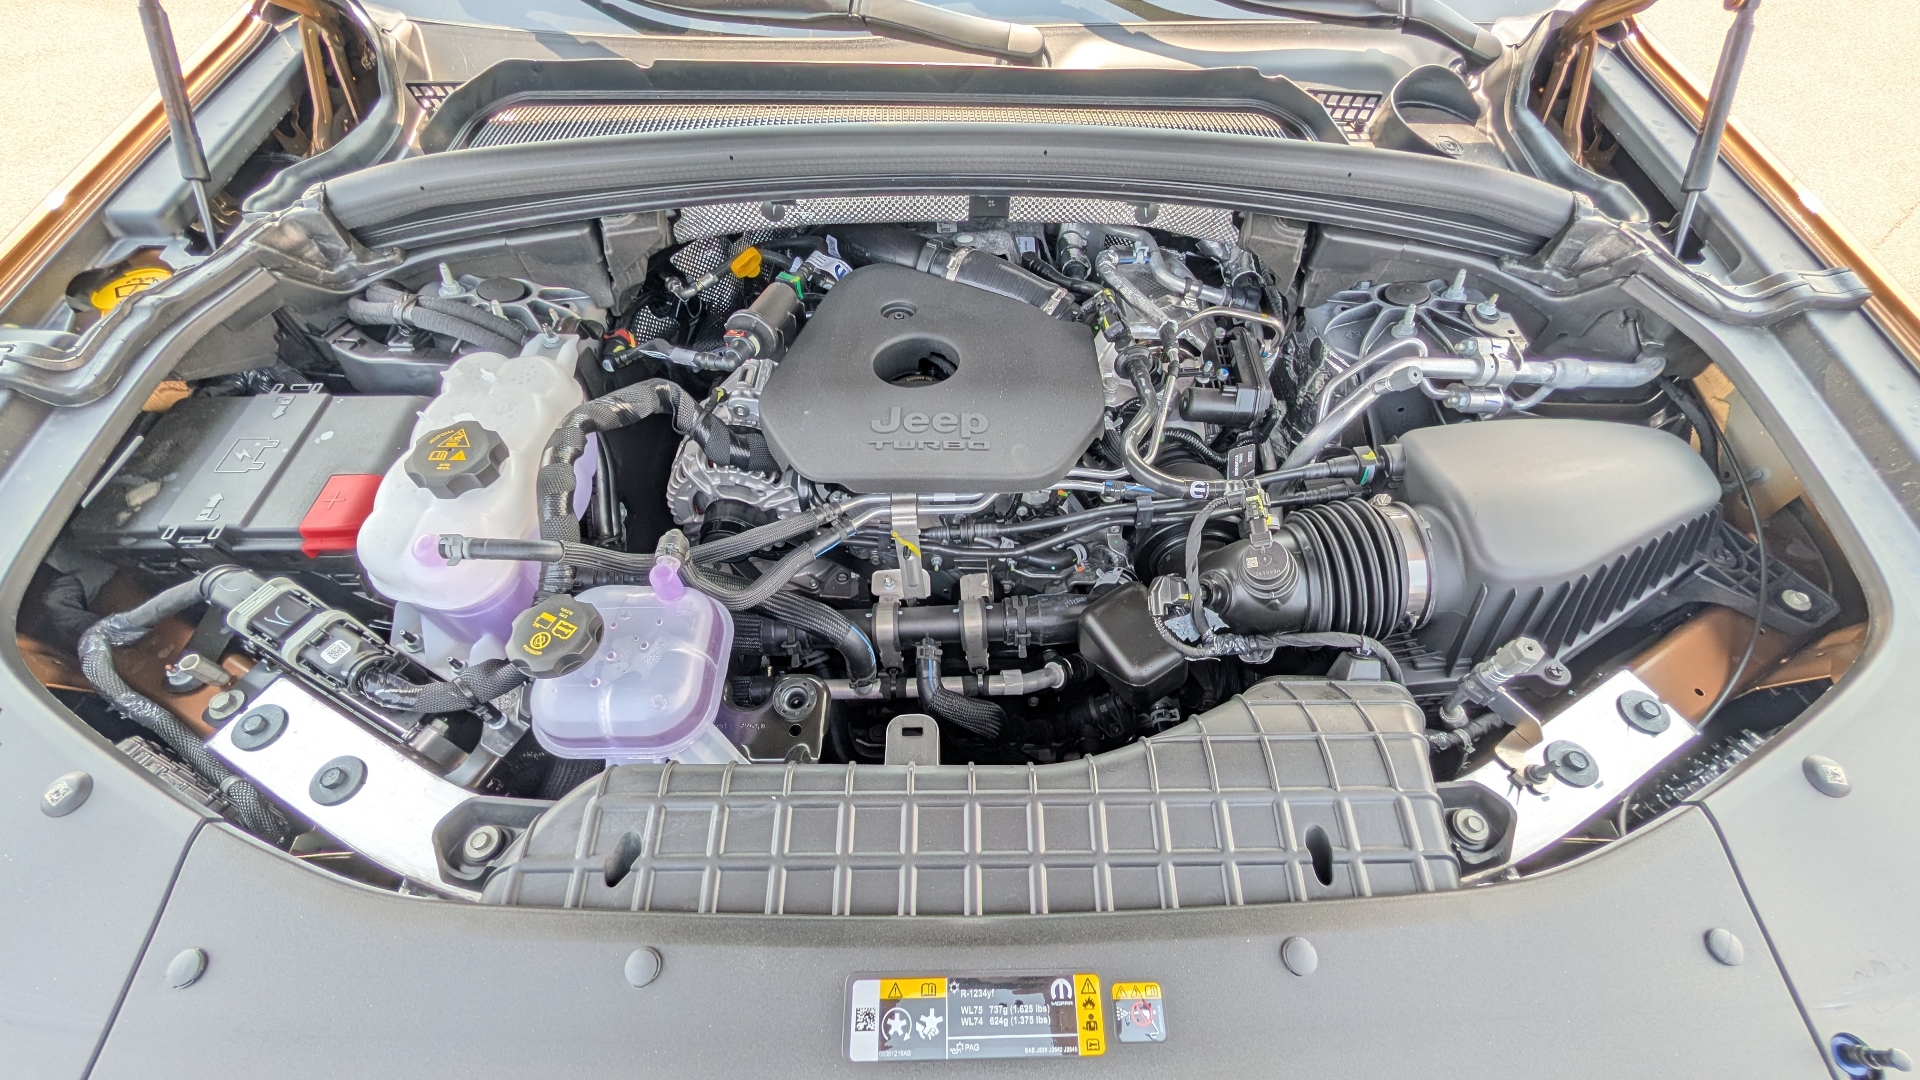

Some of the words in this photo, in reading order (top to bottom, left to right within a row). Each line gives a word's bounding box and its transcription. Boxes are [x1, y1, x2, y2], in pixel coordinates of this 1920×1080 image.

[871, 406, 989, 439] Jeep
[868, 440, 991, 451] TURBO
[960, 989, 995, 999] R-1234yf
[961, 1006, 983, 1014] WL75
[989, 1005, 1008, 1016] 737g
[1010, 1004, 1033, 1015] (1.625
[1035, 1004, 1050, 1014] lbs)
[961, 1017, 983, 1026] WL74
[989, 1016, 1008, 1027] 624g
[1010, 1015, 1034, 1026] (1.375
[1035, 1015, 1051, 1026] lbs)
